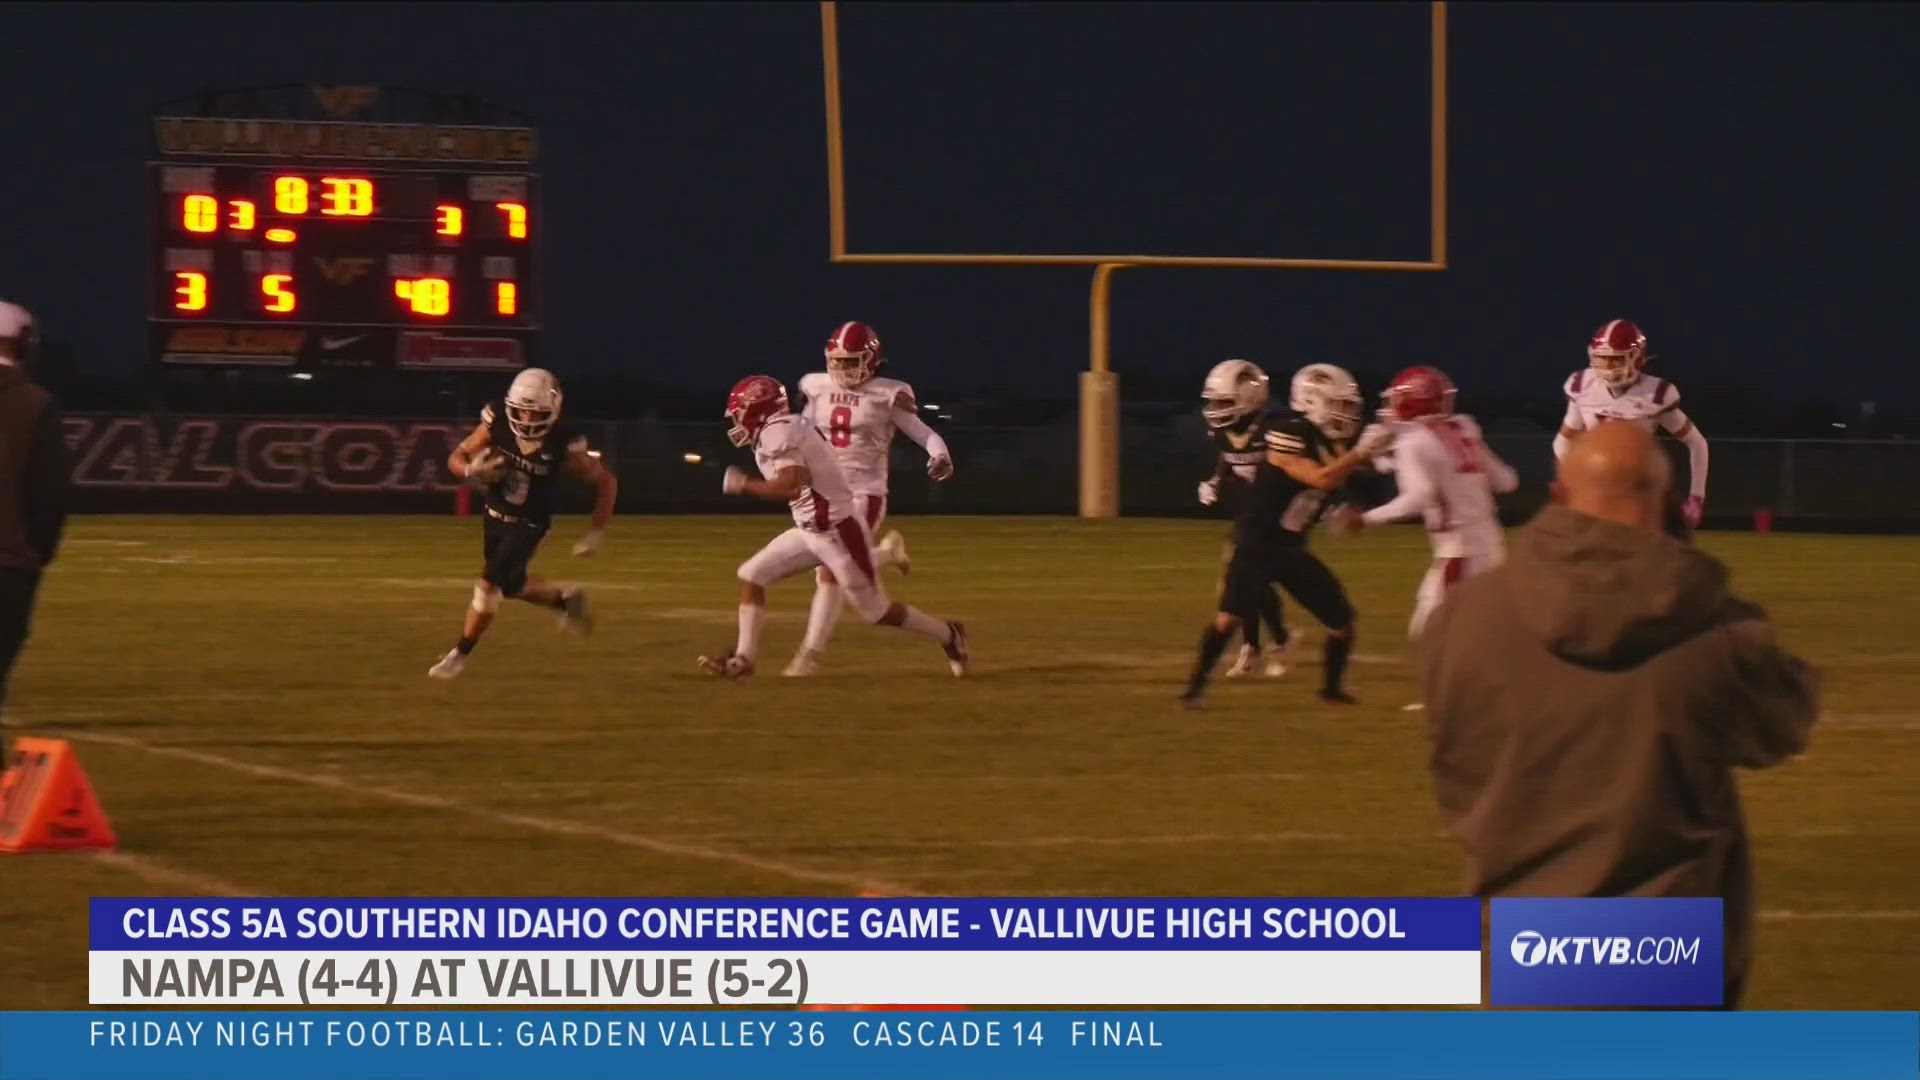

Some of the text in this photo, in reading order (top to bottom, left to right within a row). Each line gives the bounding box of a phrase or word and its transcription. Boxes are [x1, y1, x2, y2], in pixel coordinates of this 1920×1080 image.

[496, 202, 526, 238] 7
[175, 271, 207, 311] 3
[262, 274, 296, 312] 5
[830, 406, 852, 449] 8
